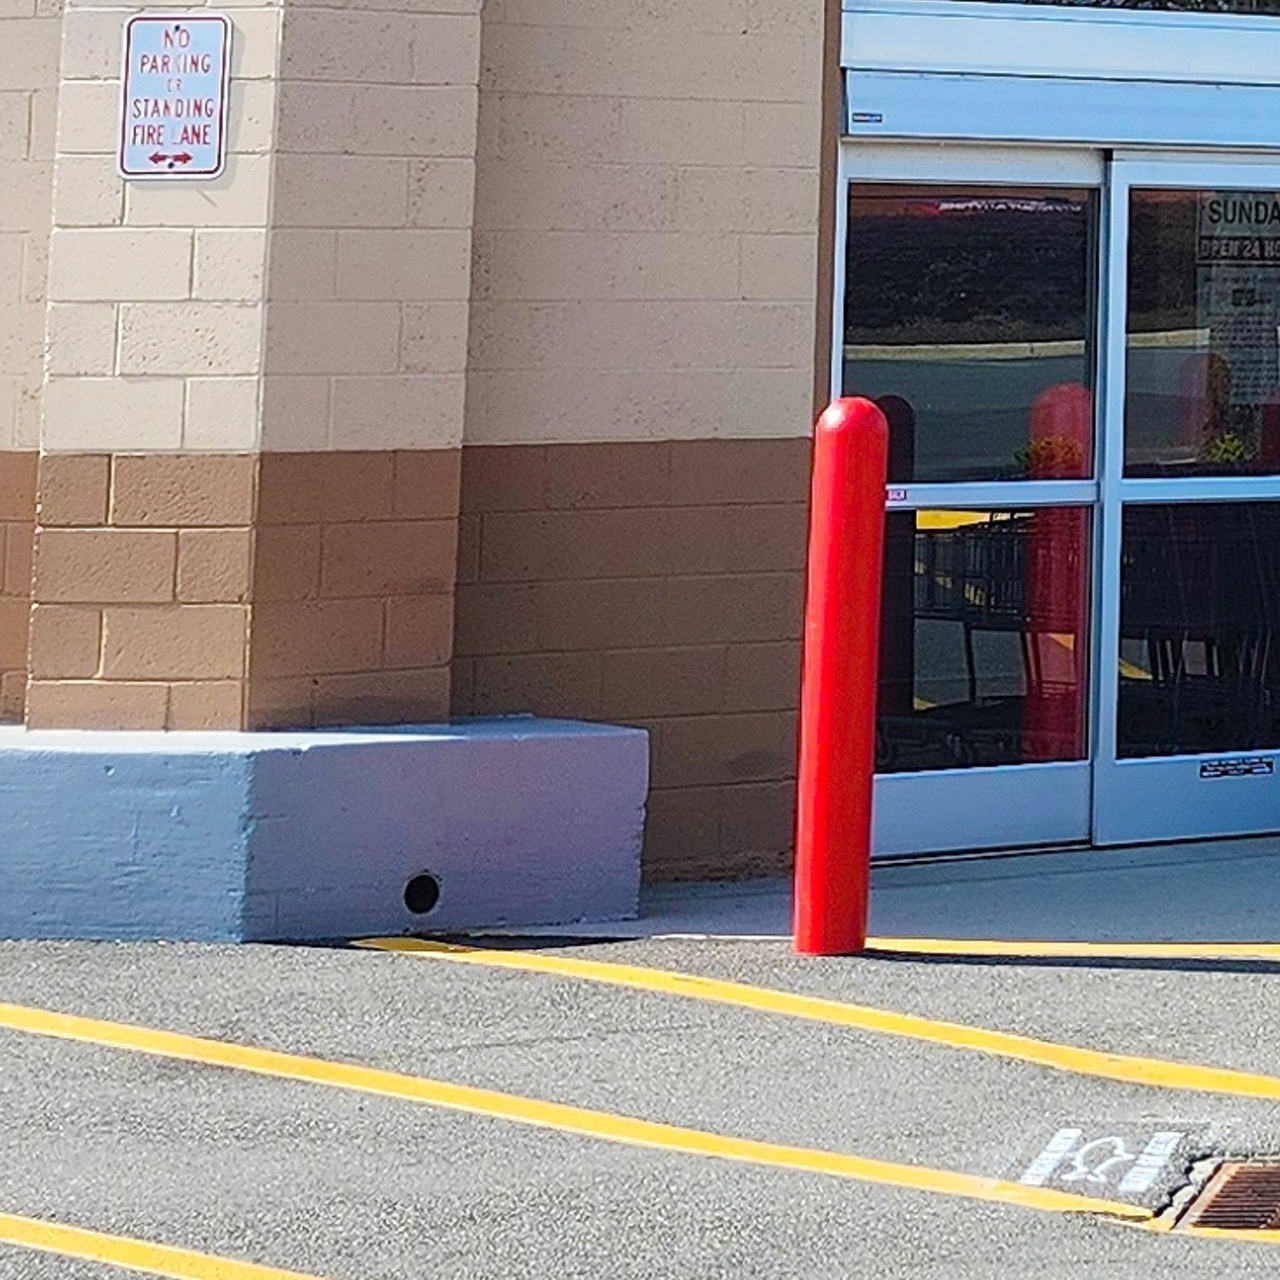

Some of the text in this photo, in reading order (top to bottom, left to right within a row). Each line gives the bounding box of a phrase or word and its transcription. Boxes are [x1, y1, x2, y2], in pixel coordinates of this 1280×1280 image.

[163, 28, 191, 48] NO
[140, 54, 212, 74] PARKING
[133, 98, 214, 119] STANDING
[132, 125, 165, 146] FIRE
[1200, 240, 1239, 257] OPEN
[1243, 241, 1260, 258] 24
